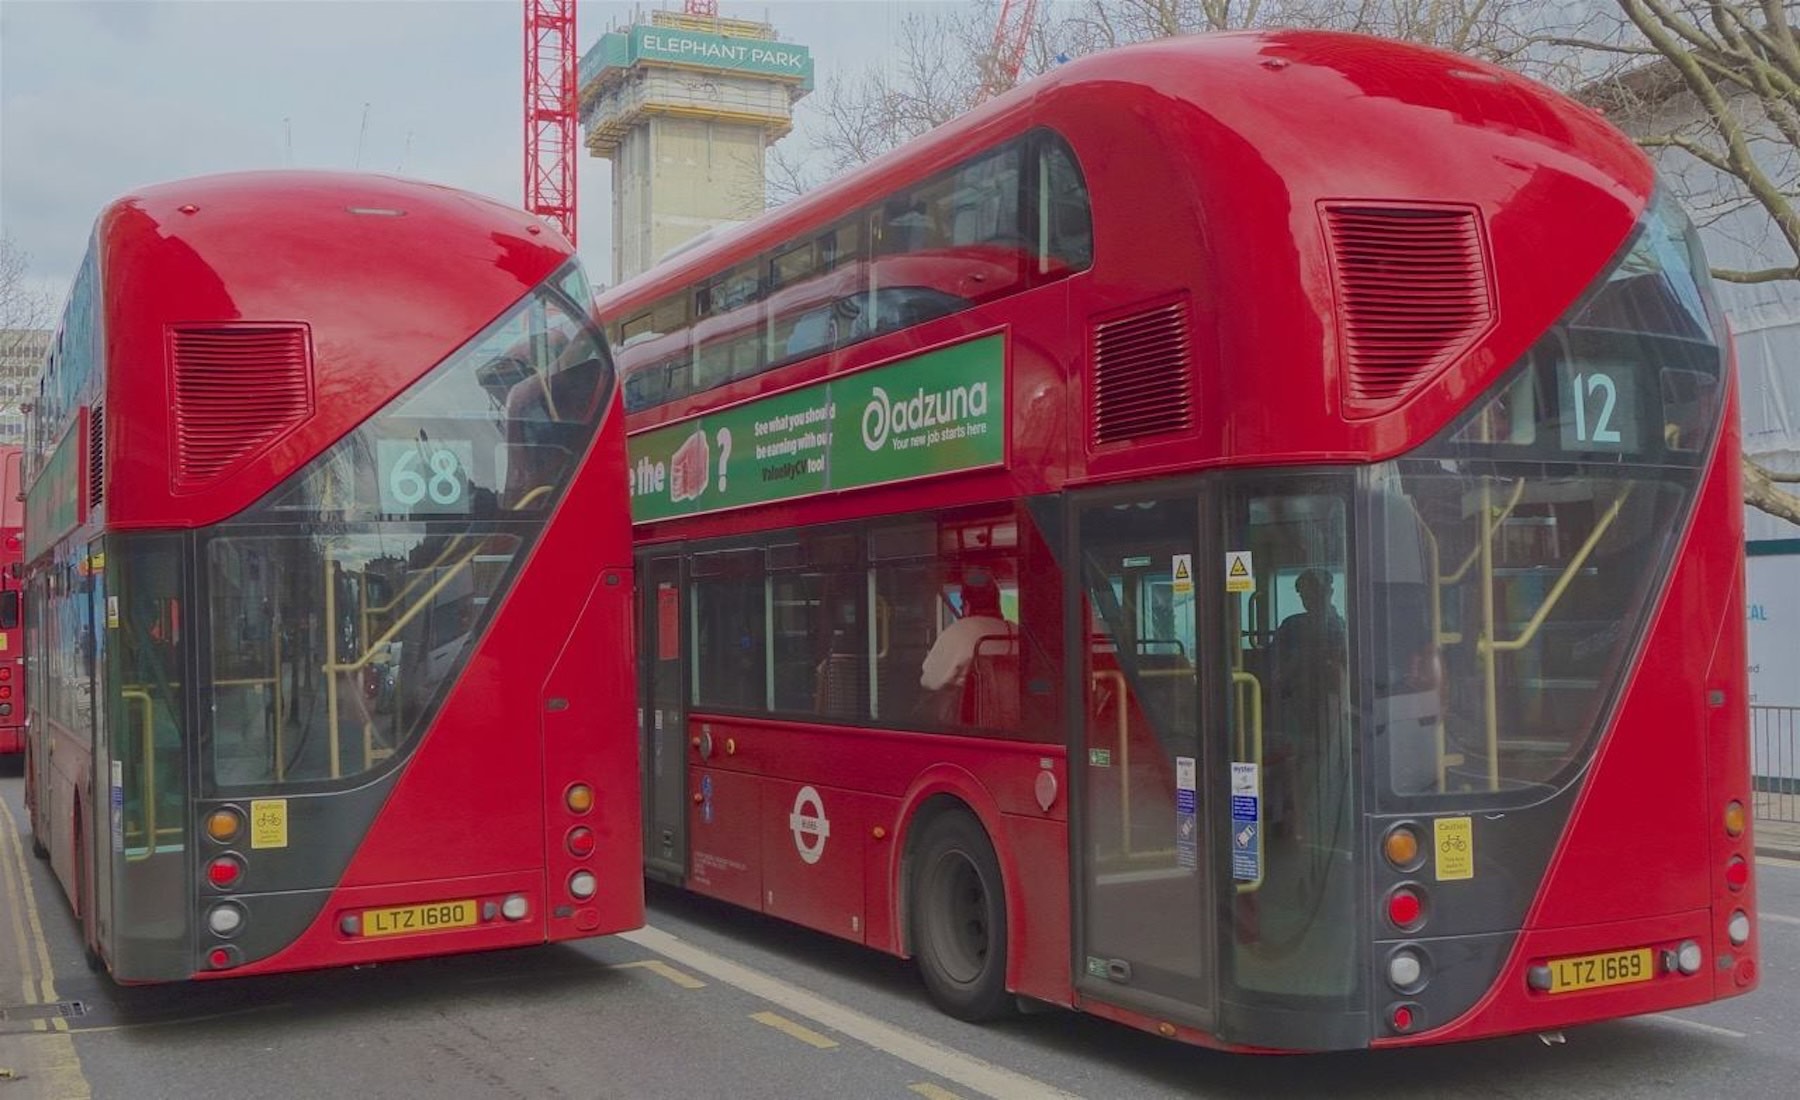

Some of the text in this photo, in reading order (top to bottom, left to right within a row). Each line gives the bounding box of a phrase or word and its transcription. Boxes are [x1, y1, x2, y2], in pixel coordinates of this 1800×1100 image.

[643, 35, 802, 68] ELEPHANT PARK
[891, 382, 987, 434] adzuna
[1574, 372, 1621, 442] 12
[754, 420, 769, 437] See
[769, 414, 789, 433] what
[788, 412, 806, 432] you
[892, 422, 987, 451] Your new job starts here
[756, 444, 767, 460] be
[767, 437, 797, 456] earning
[798, 432, 817, 451] with
[390, 449, 460, 505] 68
[637, 456, 665, 496] the
[807, 454, 825, 473] tool
[376, 905, 464, 931] LTZ 1680
[1560, 954, 1641, 987] LTZ 1669
